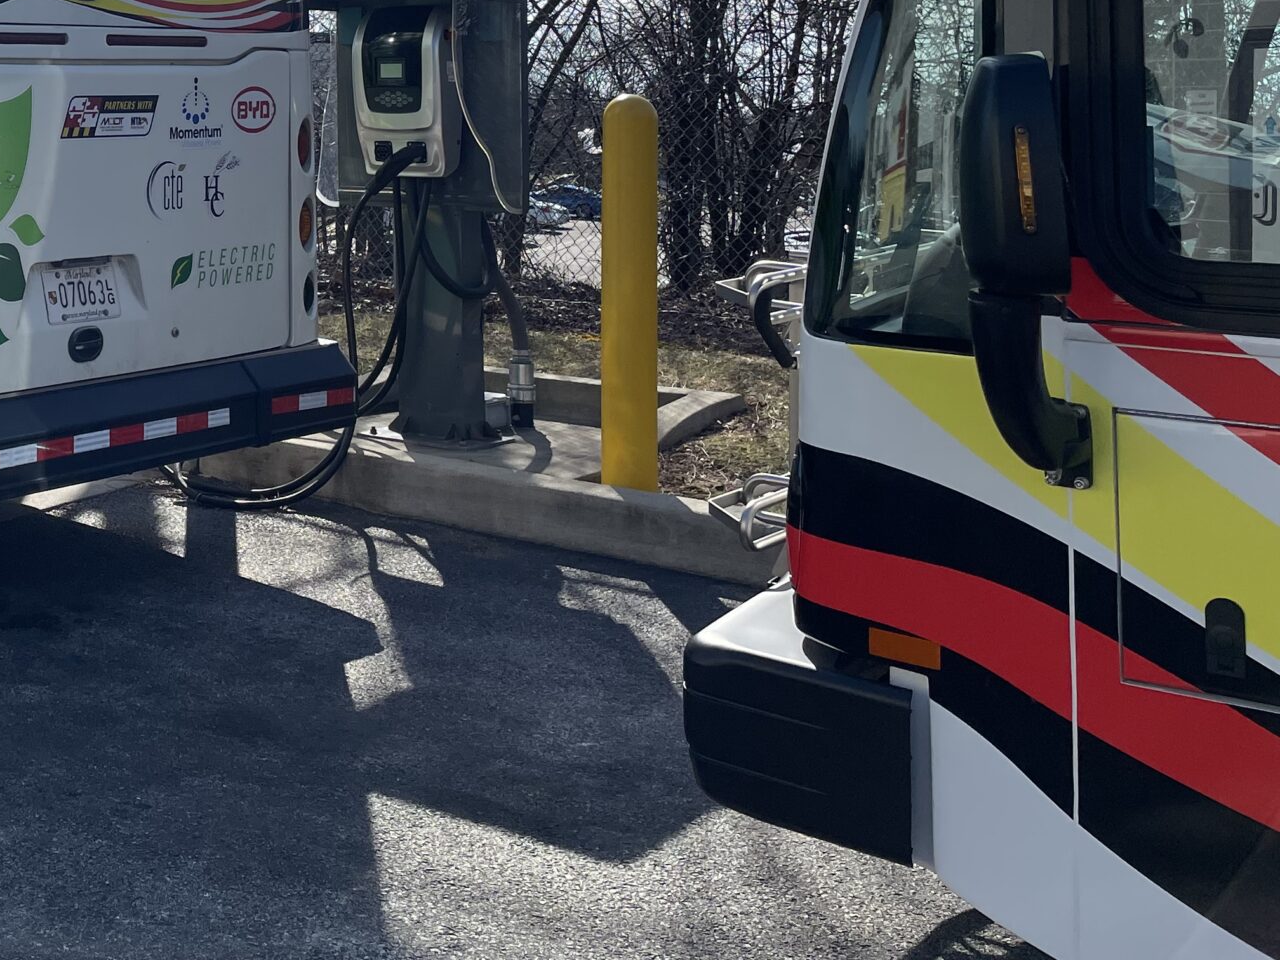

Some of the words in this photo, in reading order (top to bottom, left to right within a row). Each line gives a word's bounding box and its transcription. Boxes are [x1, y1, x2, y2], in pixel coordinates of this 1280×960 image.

[104, 101, 136, 111] PARTNERS
[136, 100, 153, 110] WITH
[237, 101, 270, 120] BYD
[169, 125, 222, 140] Momentum
[198, 243, 276, 269] ELECTRIC
[197, 263, 274, 289] POWERED
